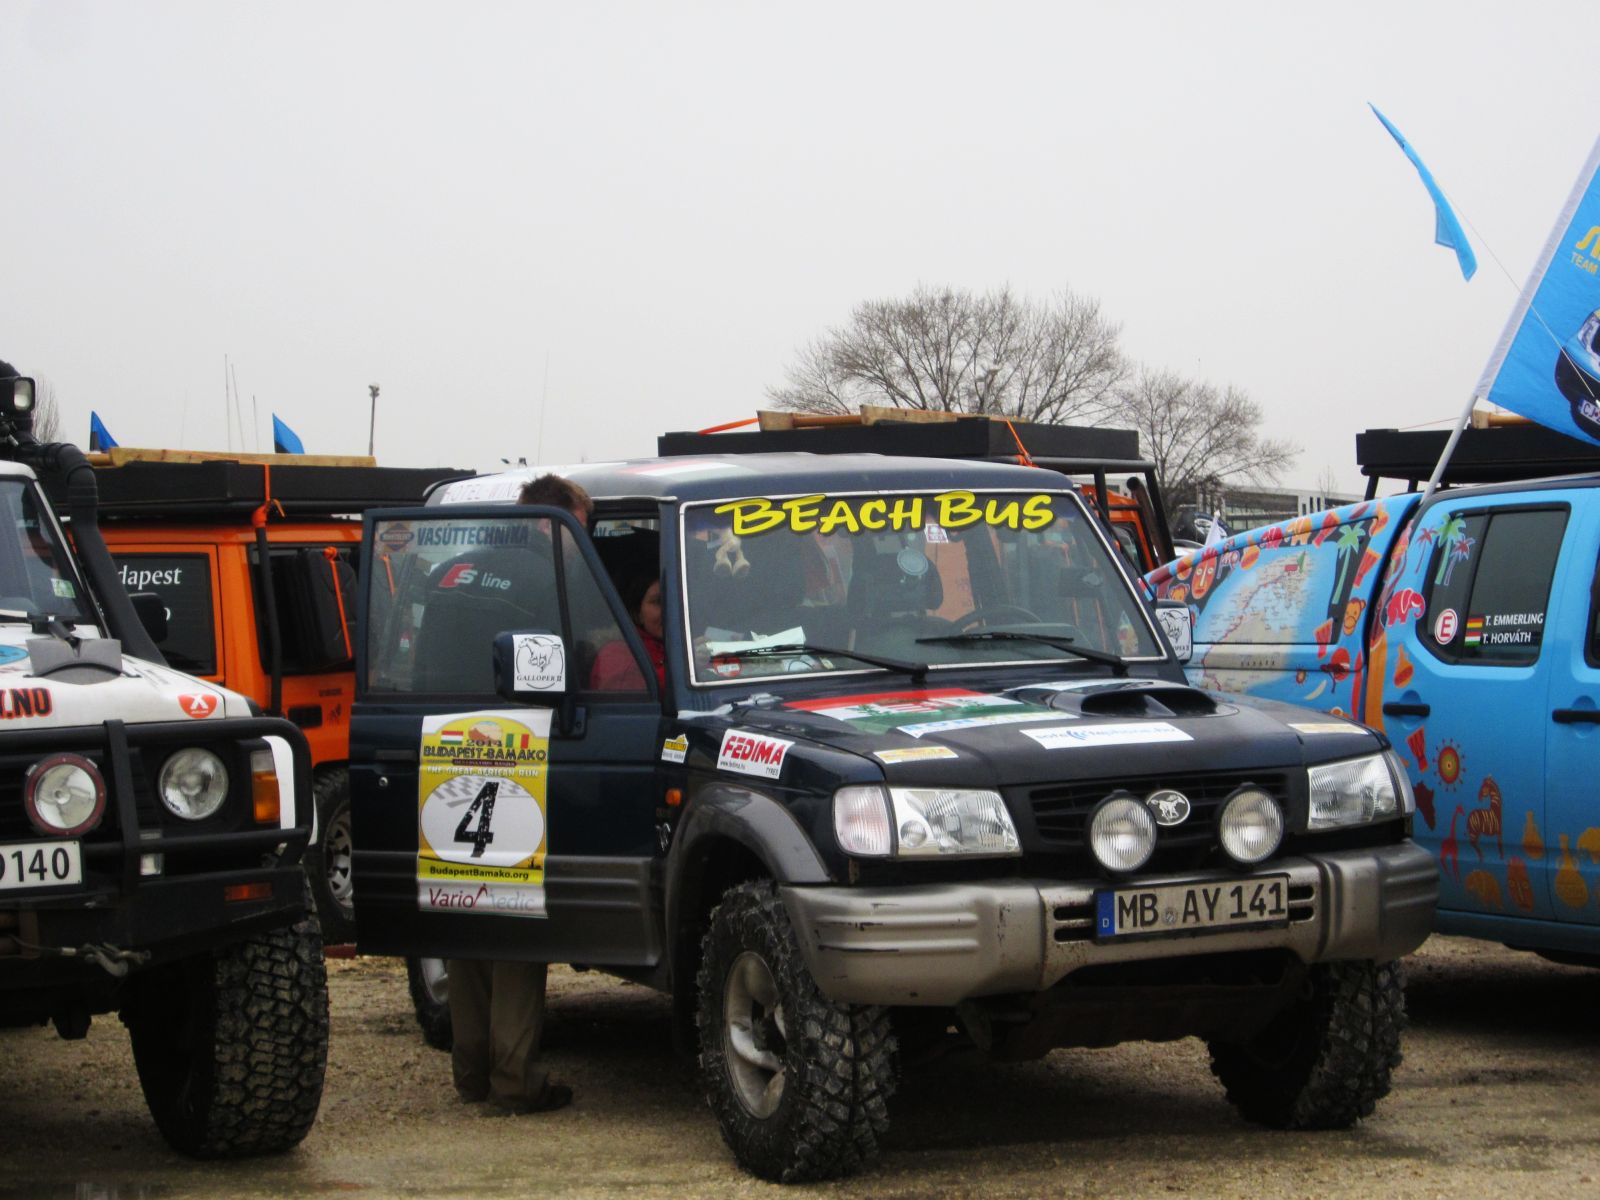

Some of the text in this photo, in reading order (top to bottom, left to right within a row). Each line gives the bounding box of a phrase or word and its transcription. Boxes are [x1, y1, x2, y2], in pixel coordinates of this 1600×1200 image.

[1571, 252, 1598, 274] TEAM
[714, 493, 923, 536] BEACH
[481, 567, 512, 590] line
[1485, 613, 1544, 626] T. EMMERLING
[1482, 629, 1532, 644] T. HORVÁTH
[722, 735, 785, 766] FEDIMA
[453, 781, 499, 858] 4
[430, 866, 529, 880] BudapestBamako.org
[1118, 893, 1158, 929] MB
[1182, 887, 1221, 923] AY
[1230, 882, 1286, 919] 141
